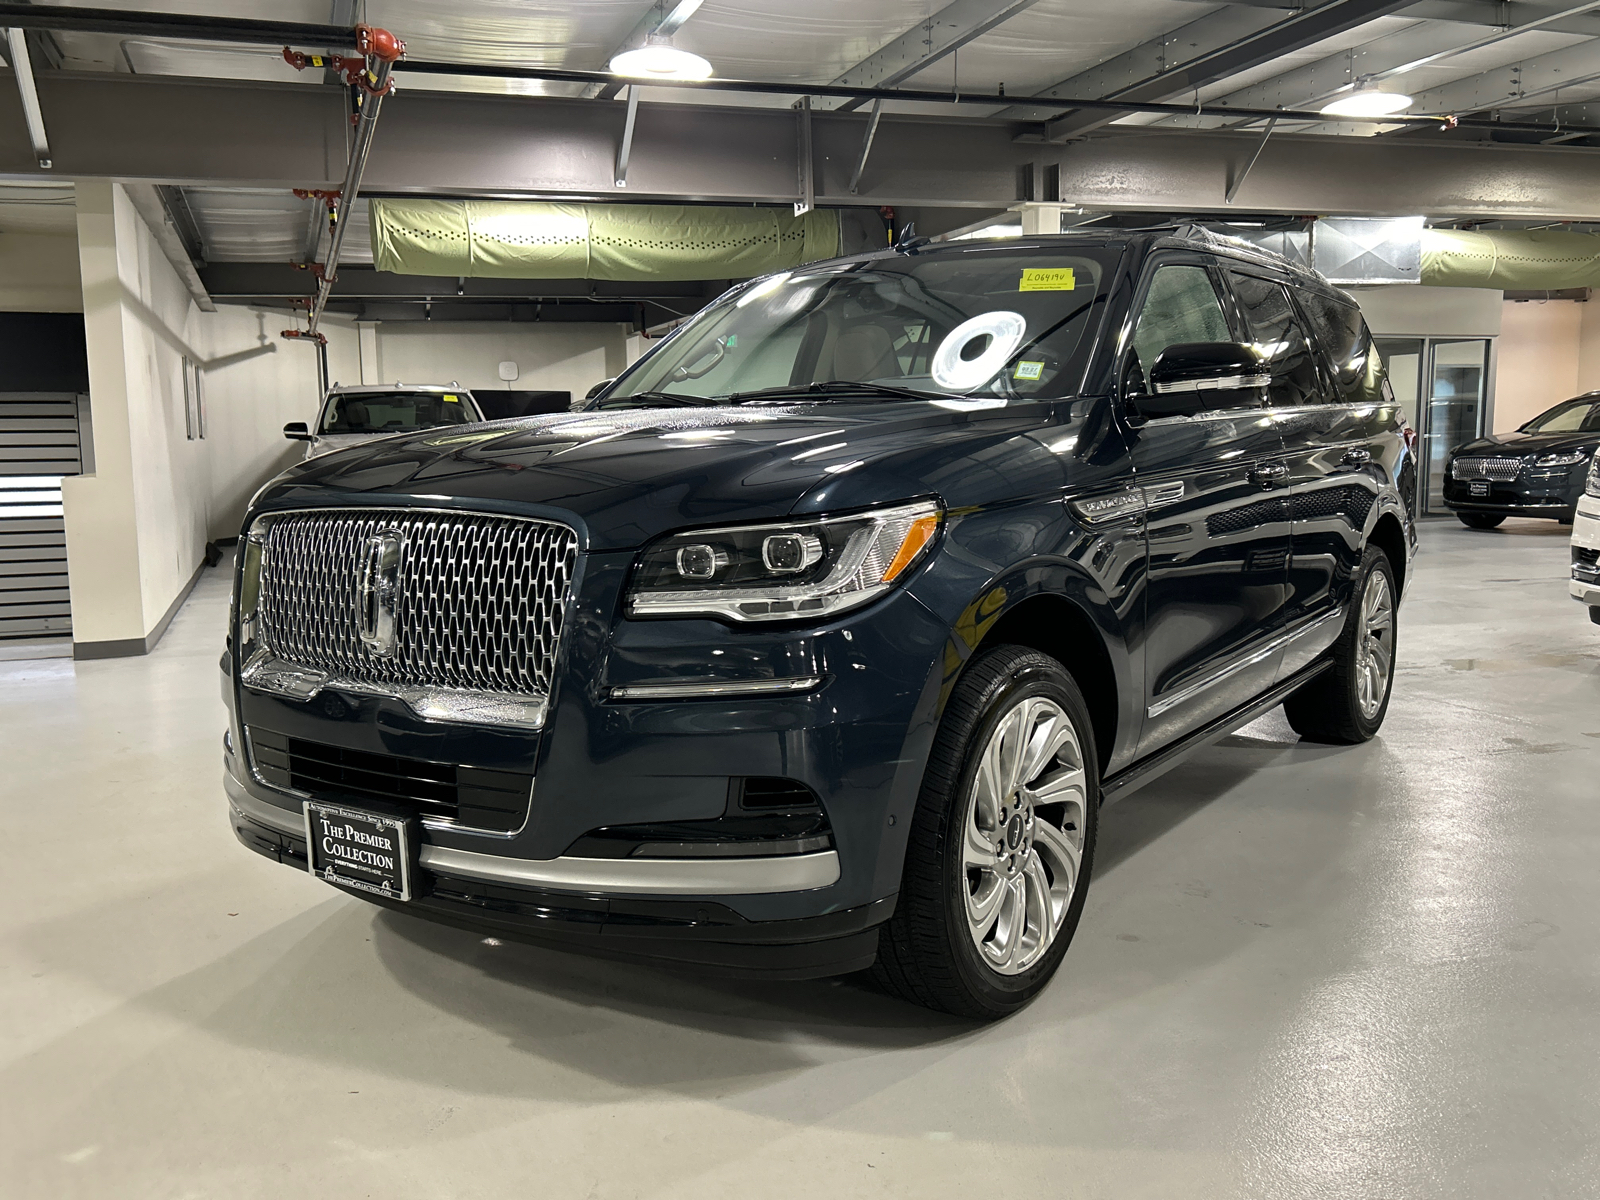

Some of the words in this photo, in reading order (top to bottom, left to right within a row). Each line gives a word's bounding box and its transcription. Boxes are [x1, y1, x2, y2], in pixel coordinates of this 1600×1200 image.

[320, 819, 344, 839] THE
[344, 824, 392, 851] PREMIER
[322, 837, 393, 870] COLLECTION
